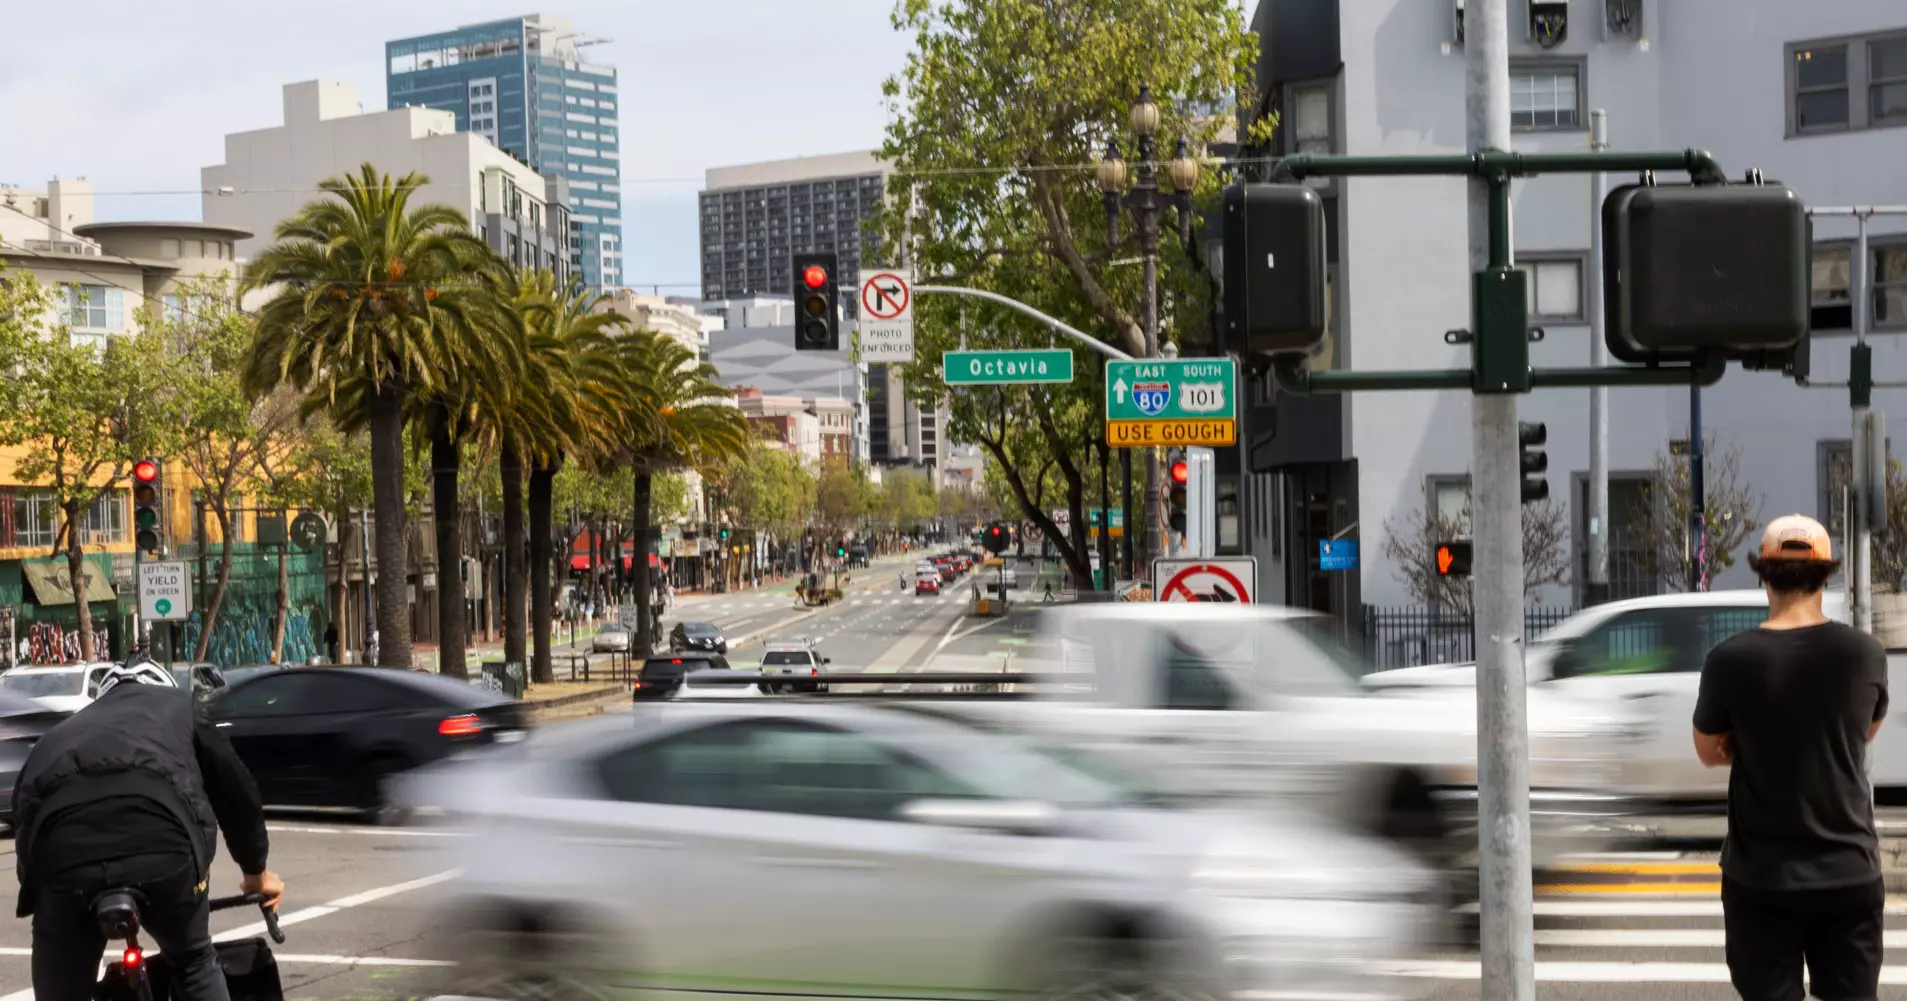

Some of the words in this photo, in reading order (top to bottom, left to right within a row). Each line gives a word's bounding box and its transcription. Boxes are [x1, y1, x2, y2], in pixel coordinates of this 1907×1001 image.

[870, 329, 902, 338] PHOTO
[862, 343, 911, 353] ENFORCED
[969, 358, 1047, 376] Octavia
[1135, 365, 1166, 378] EAST
[1183, 364, 1222, 377] SOUTH
[1140, 392, 1163, 410] 80
[1190, 389, 1214, 406] 101
[1117, 424, 1153, 441] USE
[1162, 423, 1225, 441] GOUGH
[143, 566, 159, 574] LEFT
[163, 565, 180, 573] TURN
[147, 575, 178, 586] YIELD
[146, 588, 155, 597] ON
[158, 587, 179, 596] GREEN
